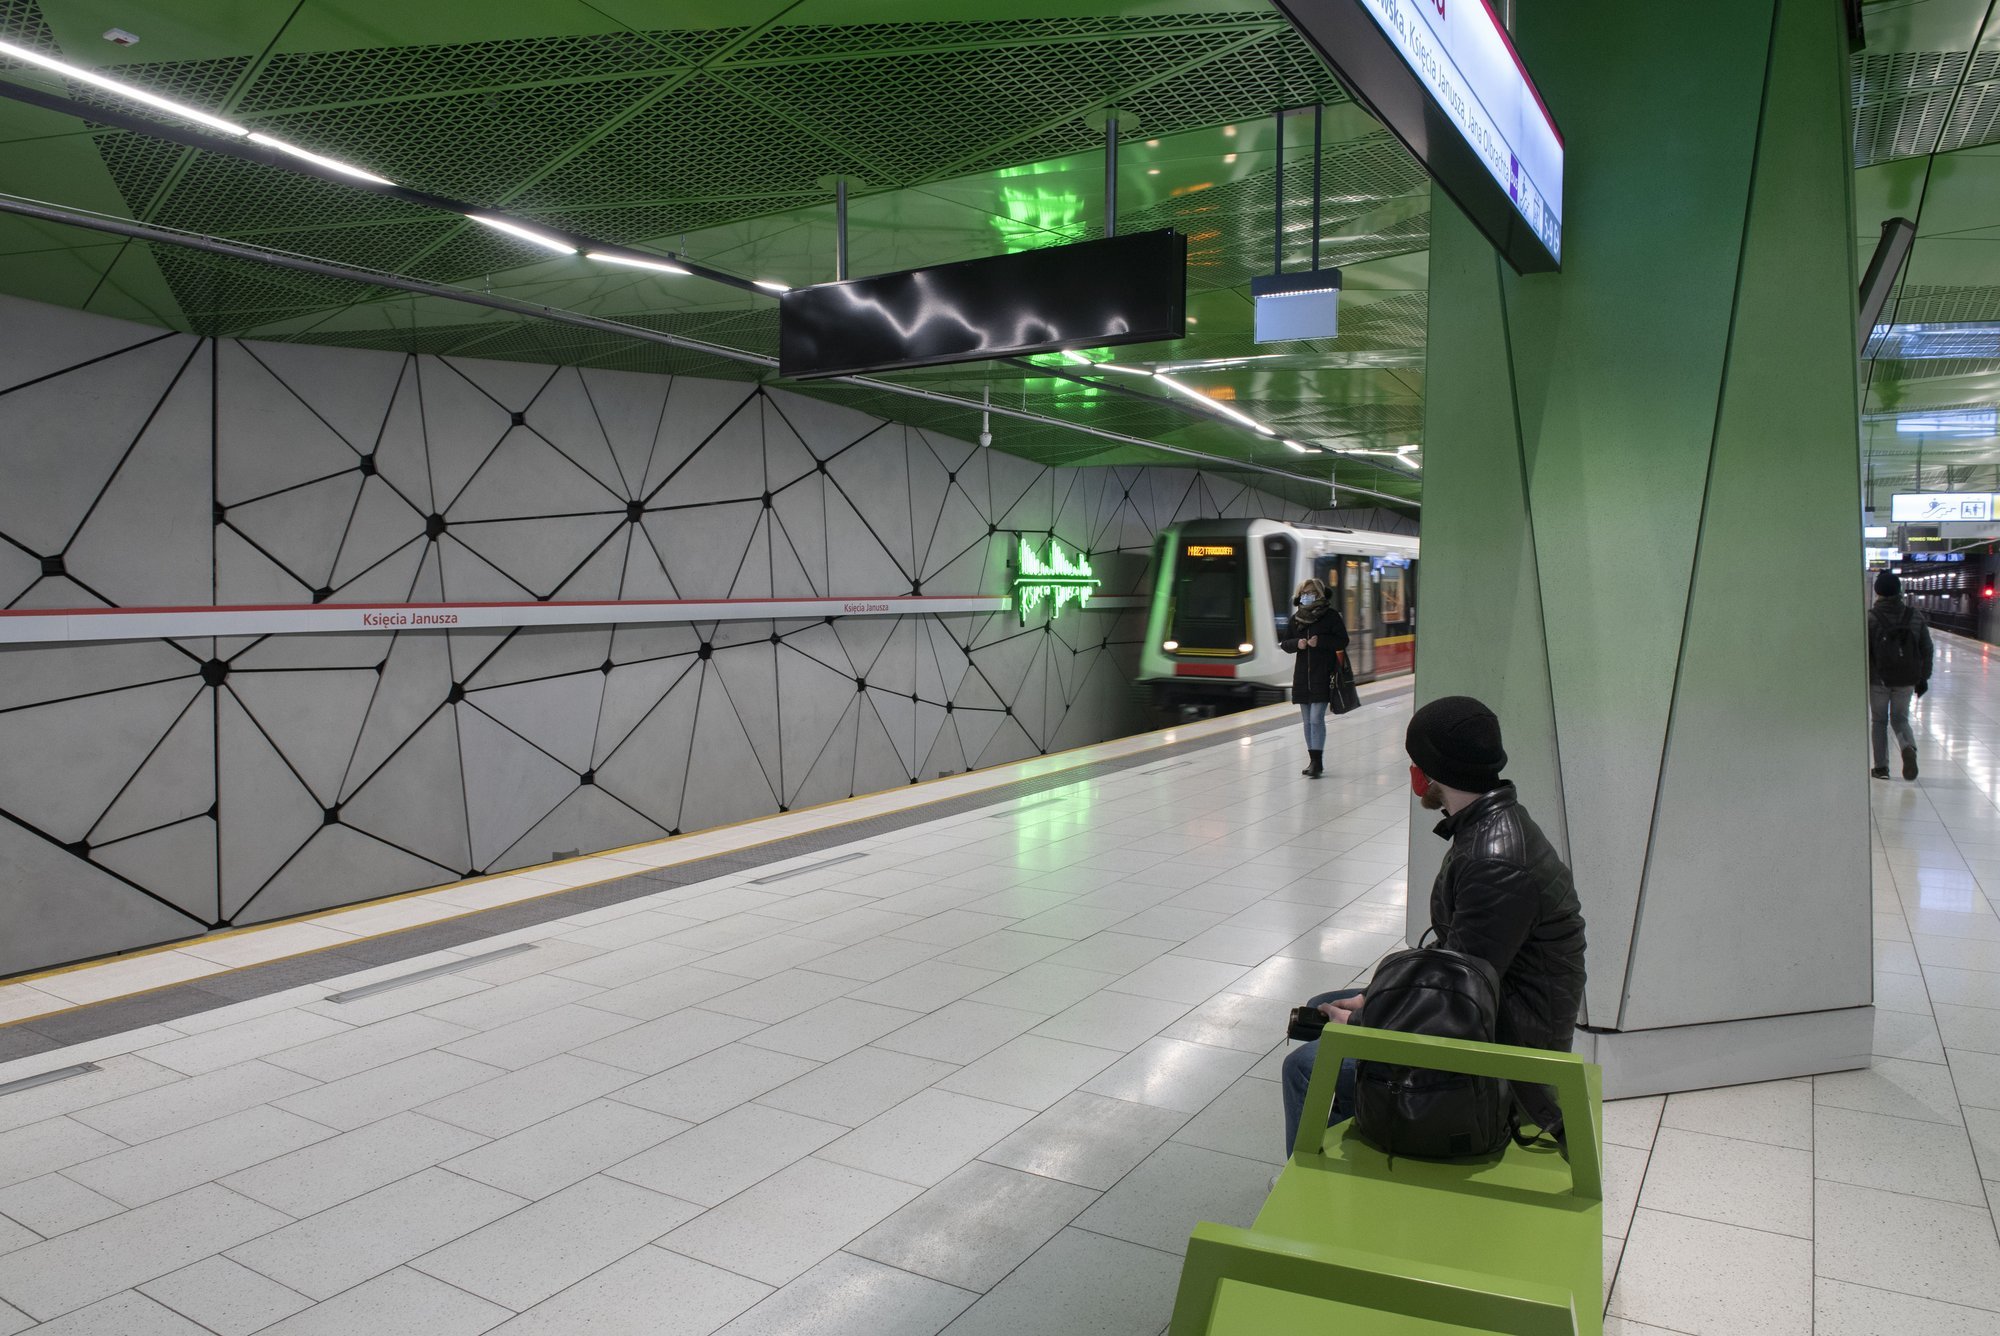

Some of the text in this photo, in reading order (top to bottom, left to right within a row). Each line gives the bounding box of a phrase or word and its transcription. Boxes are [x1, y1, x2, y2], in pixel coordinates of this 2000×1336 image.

[1410, 20, 1436, 80] Księcia
[1438, 64, 1467, 127] Janusza,
[1468, 107, 1482, 144] Jana
[1483, 129, 1510, 182] Olbrachta
[844, 602, 889, 614] Księcia Janusza
[363, 612, 458, 628] Księcia Janusza
